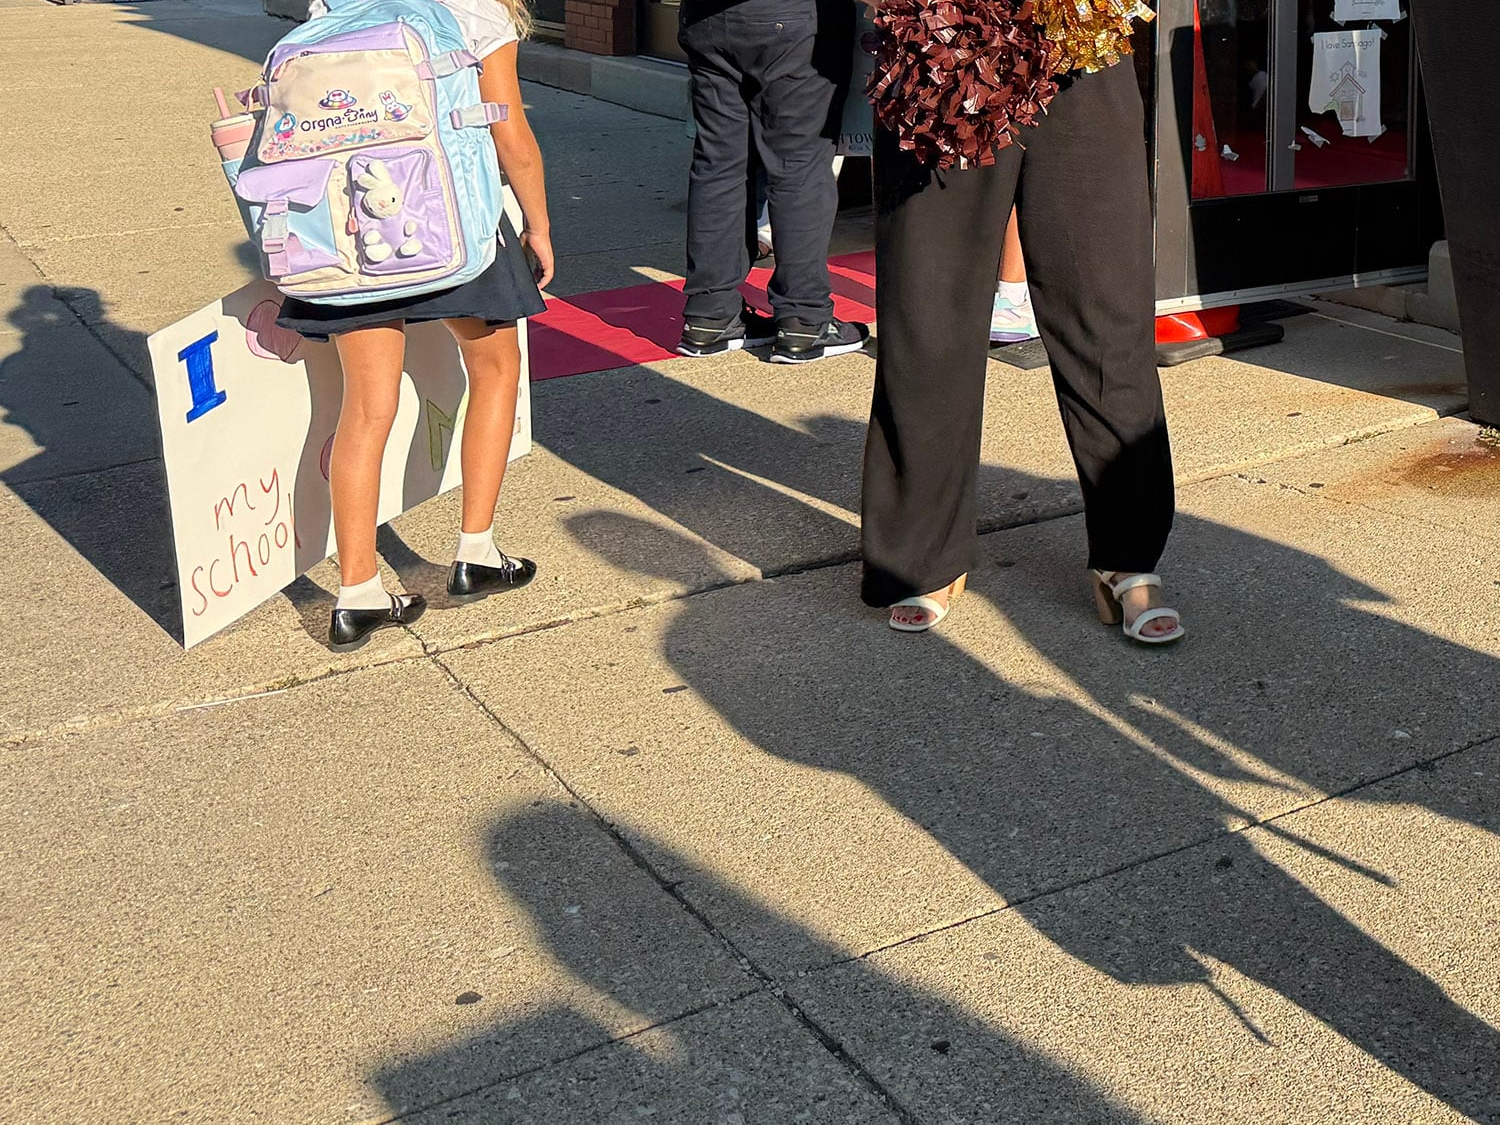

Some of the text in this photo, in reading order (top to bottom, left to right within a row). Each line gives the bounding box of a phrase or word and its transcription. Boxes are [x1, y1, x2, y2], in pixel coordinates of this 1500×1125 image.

[178, 330, 228, 424] I
[214, 468, 281, 531] my
[192, 492, 302, 617] school
